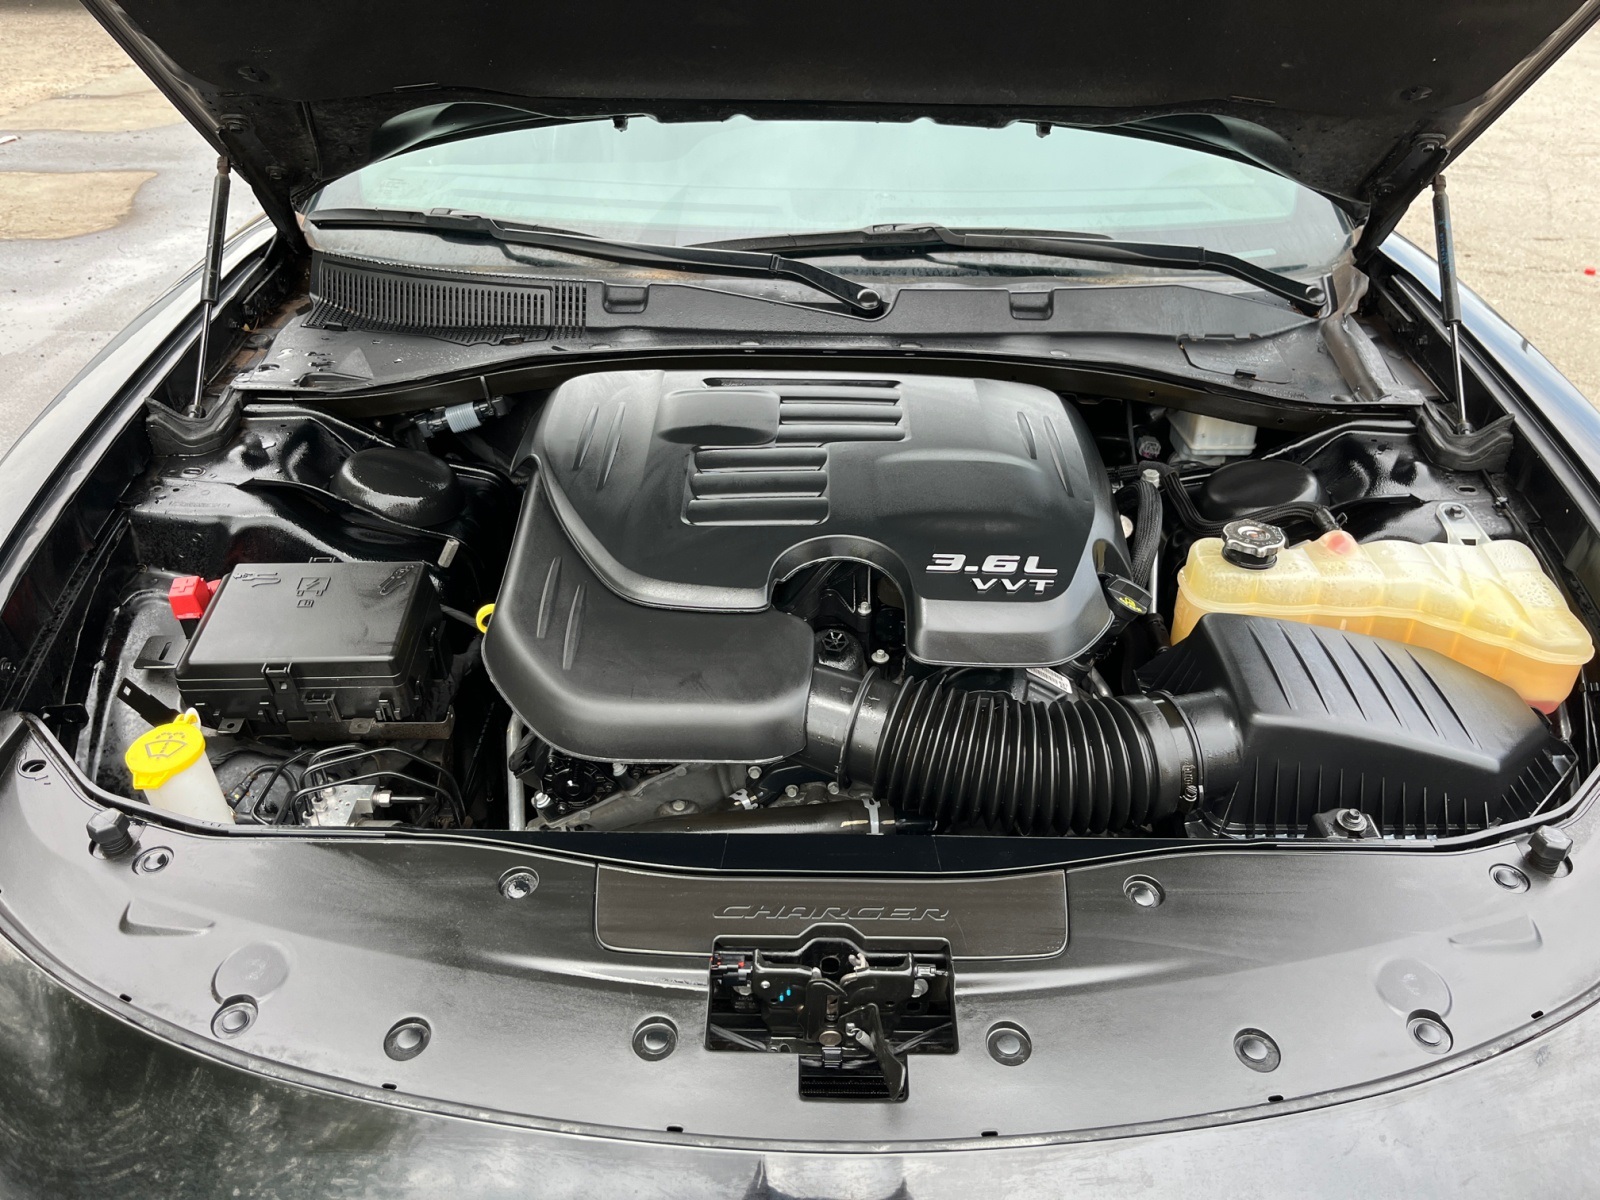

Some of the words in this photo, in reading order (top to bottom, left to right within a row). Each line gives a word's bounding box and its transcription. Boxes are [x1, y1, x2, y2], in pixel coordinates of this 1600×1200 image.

[925, 553, 1058, 576] 3.6L
[971, 577, 1055, 594] VVT
[712, 904, 950, 922] CHARGER
